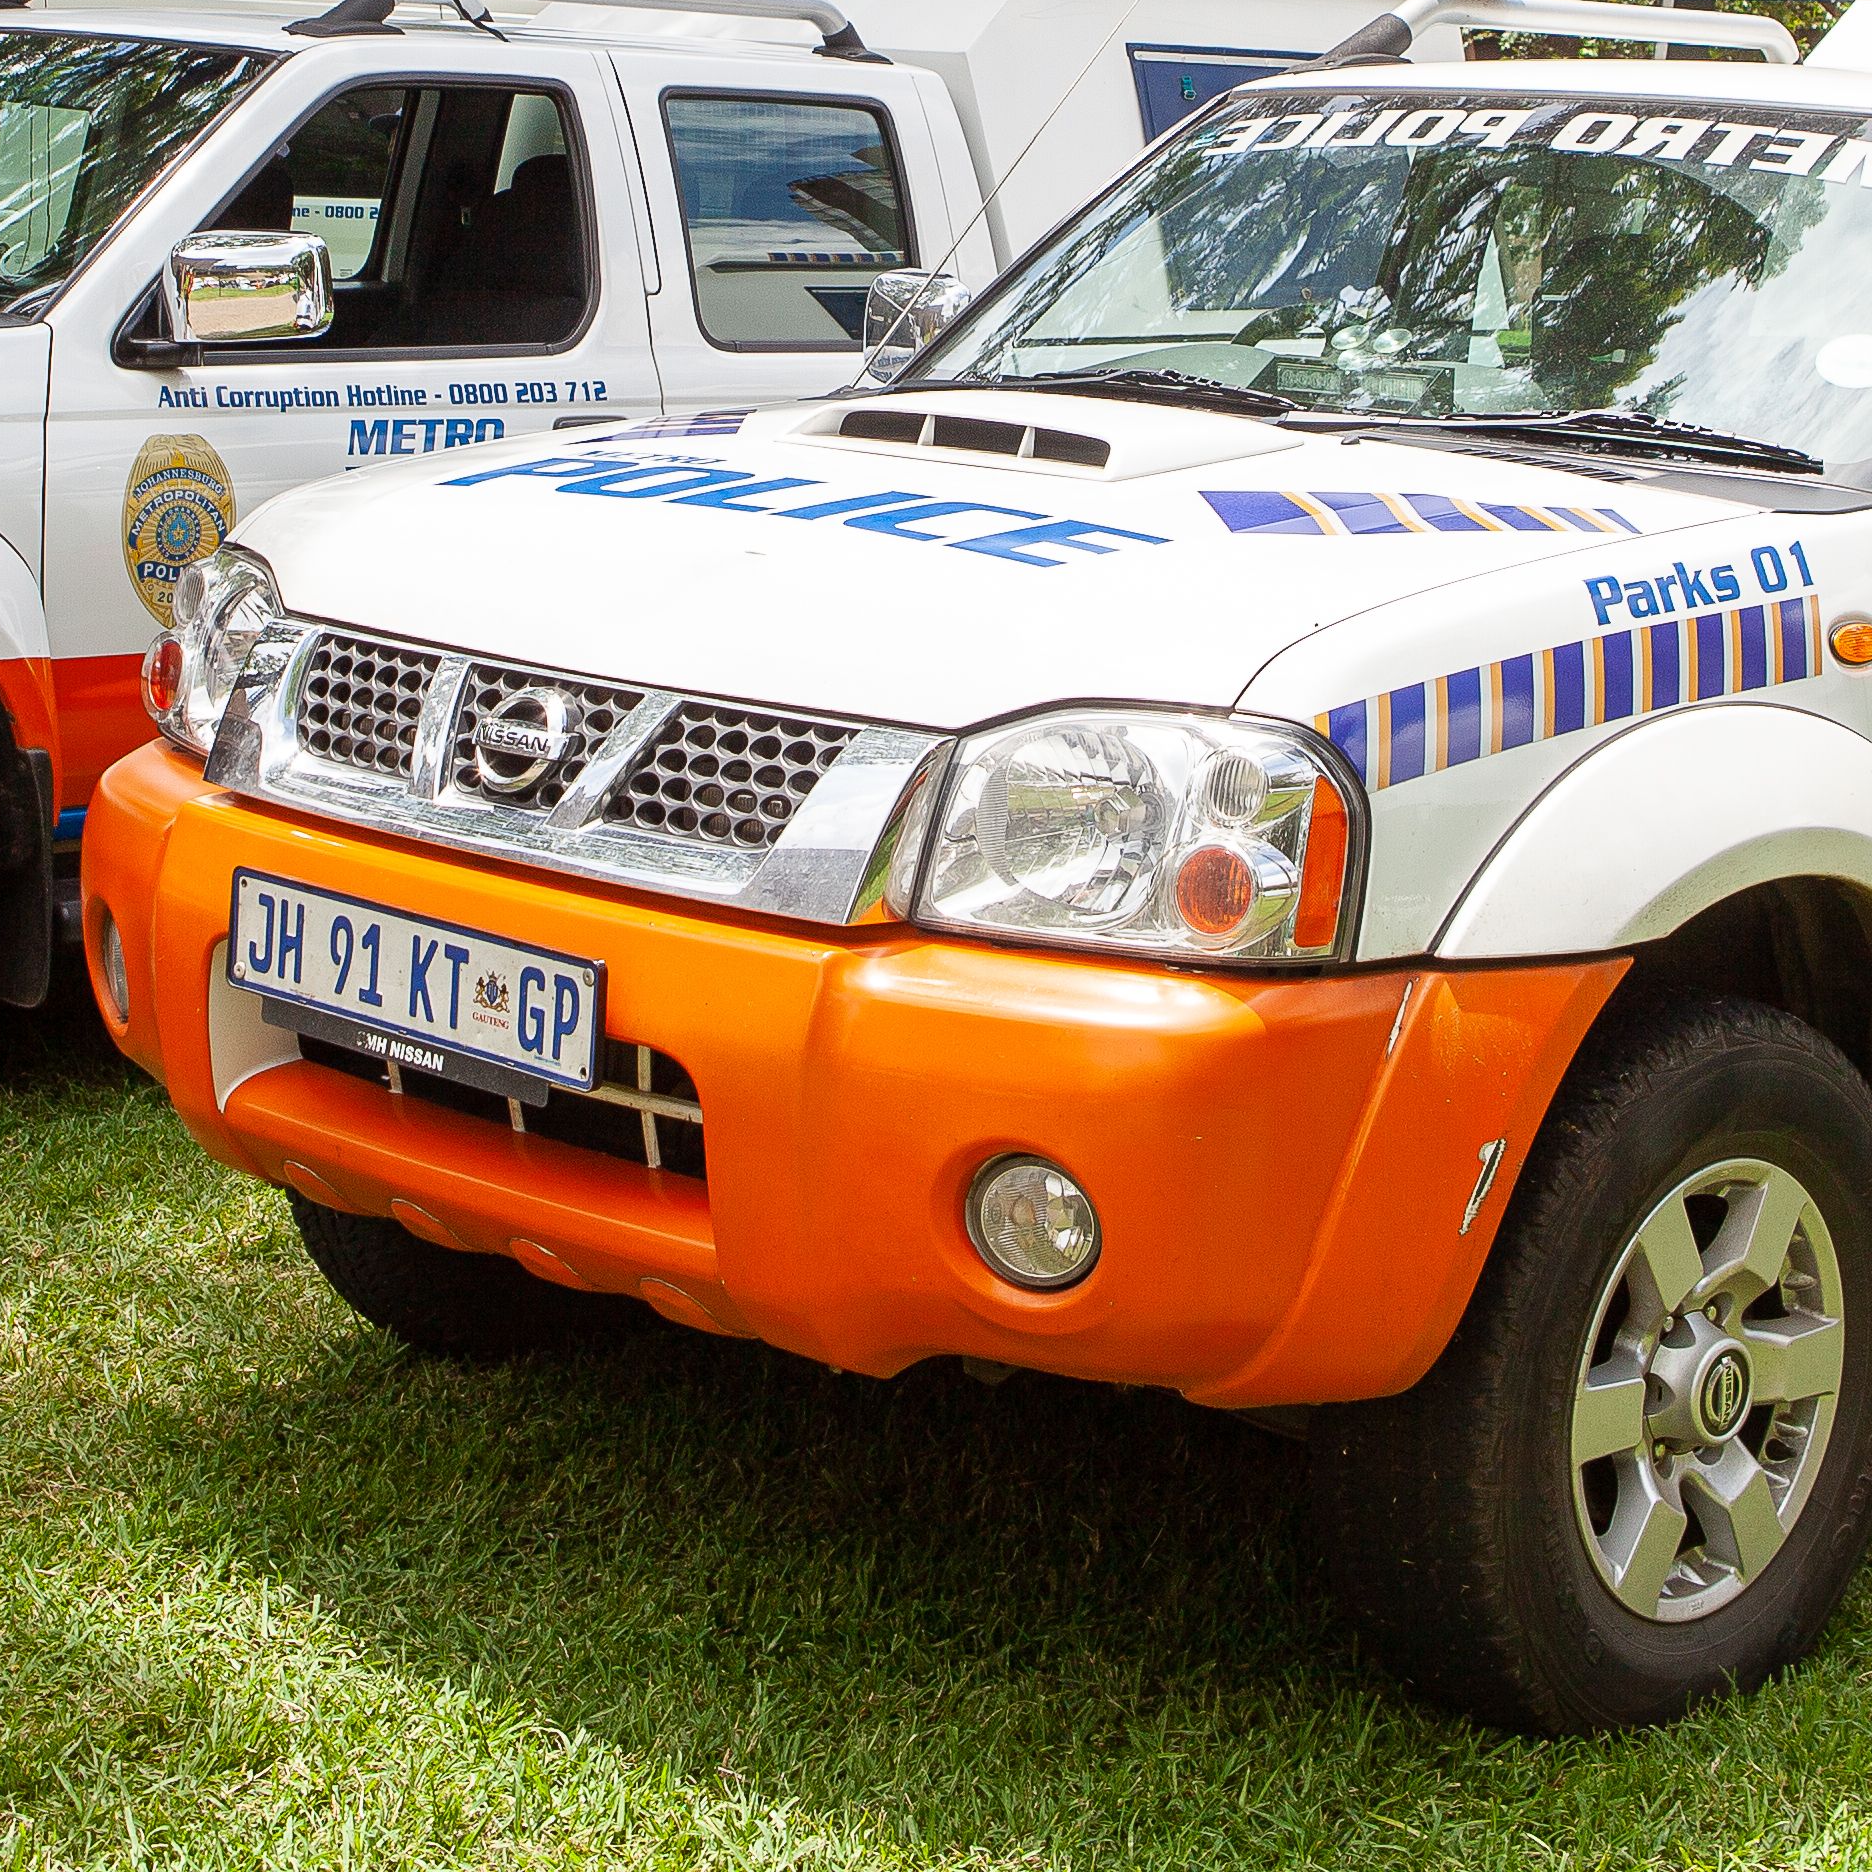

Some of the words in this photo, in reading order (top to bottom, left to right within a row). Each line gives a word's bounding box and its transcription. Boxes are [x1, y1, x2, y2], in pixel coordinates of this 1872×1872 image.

[158, 385, 208, 409] Anti
[216, 385, 340, 413] Corruption
[347, 385, 427, 408] Hotline
[449, 382, 509, 406] 0800
[515, 381, 559, 404] 203
[564, 380, 609, 403] 712
[347, 418, 505, 456] METRO
[135, 467, 226, 499] JOHANNESBURG
[131, 489, 226, 537] METROPOLITAN
[434, 458, 1173, 568] POLICE
[144, 562, 184, 581] POL
[1583, 562, 1741, 626] Parks
[1750, 541, 1814, 593] 01
[157, 591, 174, 604] 20
[478, 723, 549, 752] NISSAN
[249, 892, 306, 984] JH
[330, 915, 383, 1008] 91
[409, 934, 471, 1030] KT
[518, 965, 581, 1060] GP
[472, 1011, 510, 1030] GAUTENG
[389, 1039, 445, 1072] NISSAN
